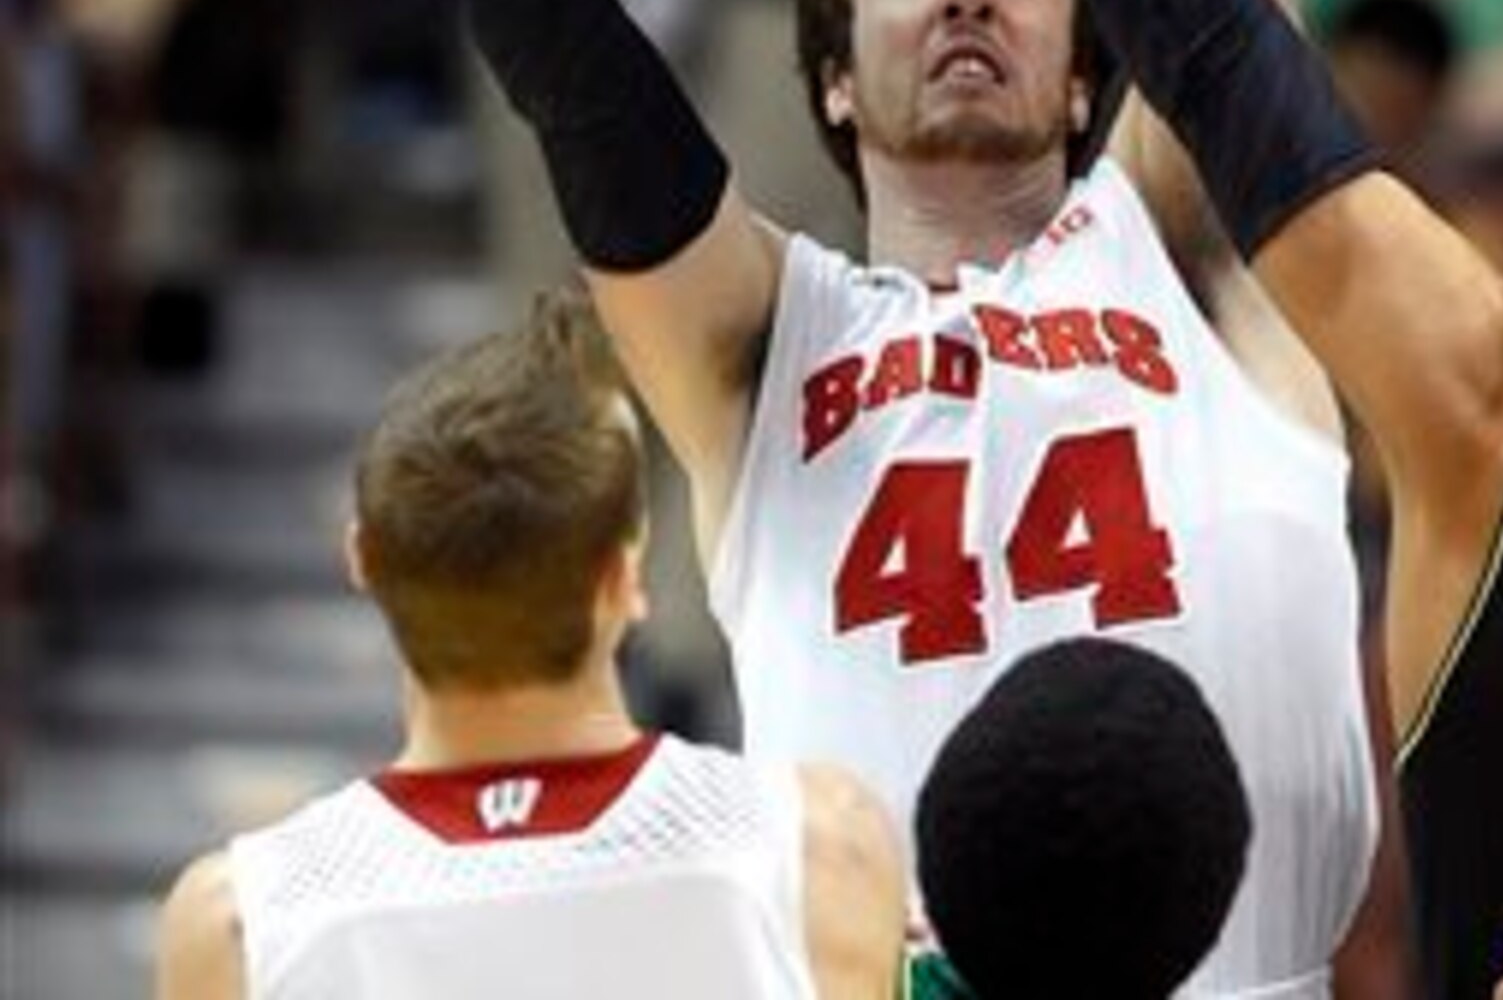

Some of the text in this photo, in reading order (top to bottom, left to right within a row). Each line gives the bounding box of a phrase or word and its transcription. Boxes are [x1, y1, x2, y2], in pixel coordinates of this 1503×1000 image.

[803, 303, 1178, 465] BADERS
[833, 427, 1181, 666] 44
[476, 777, 543, 833] W
